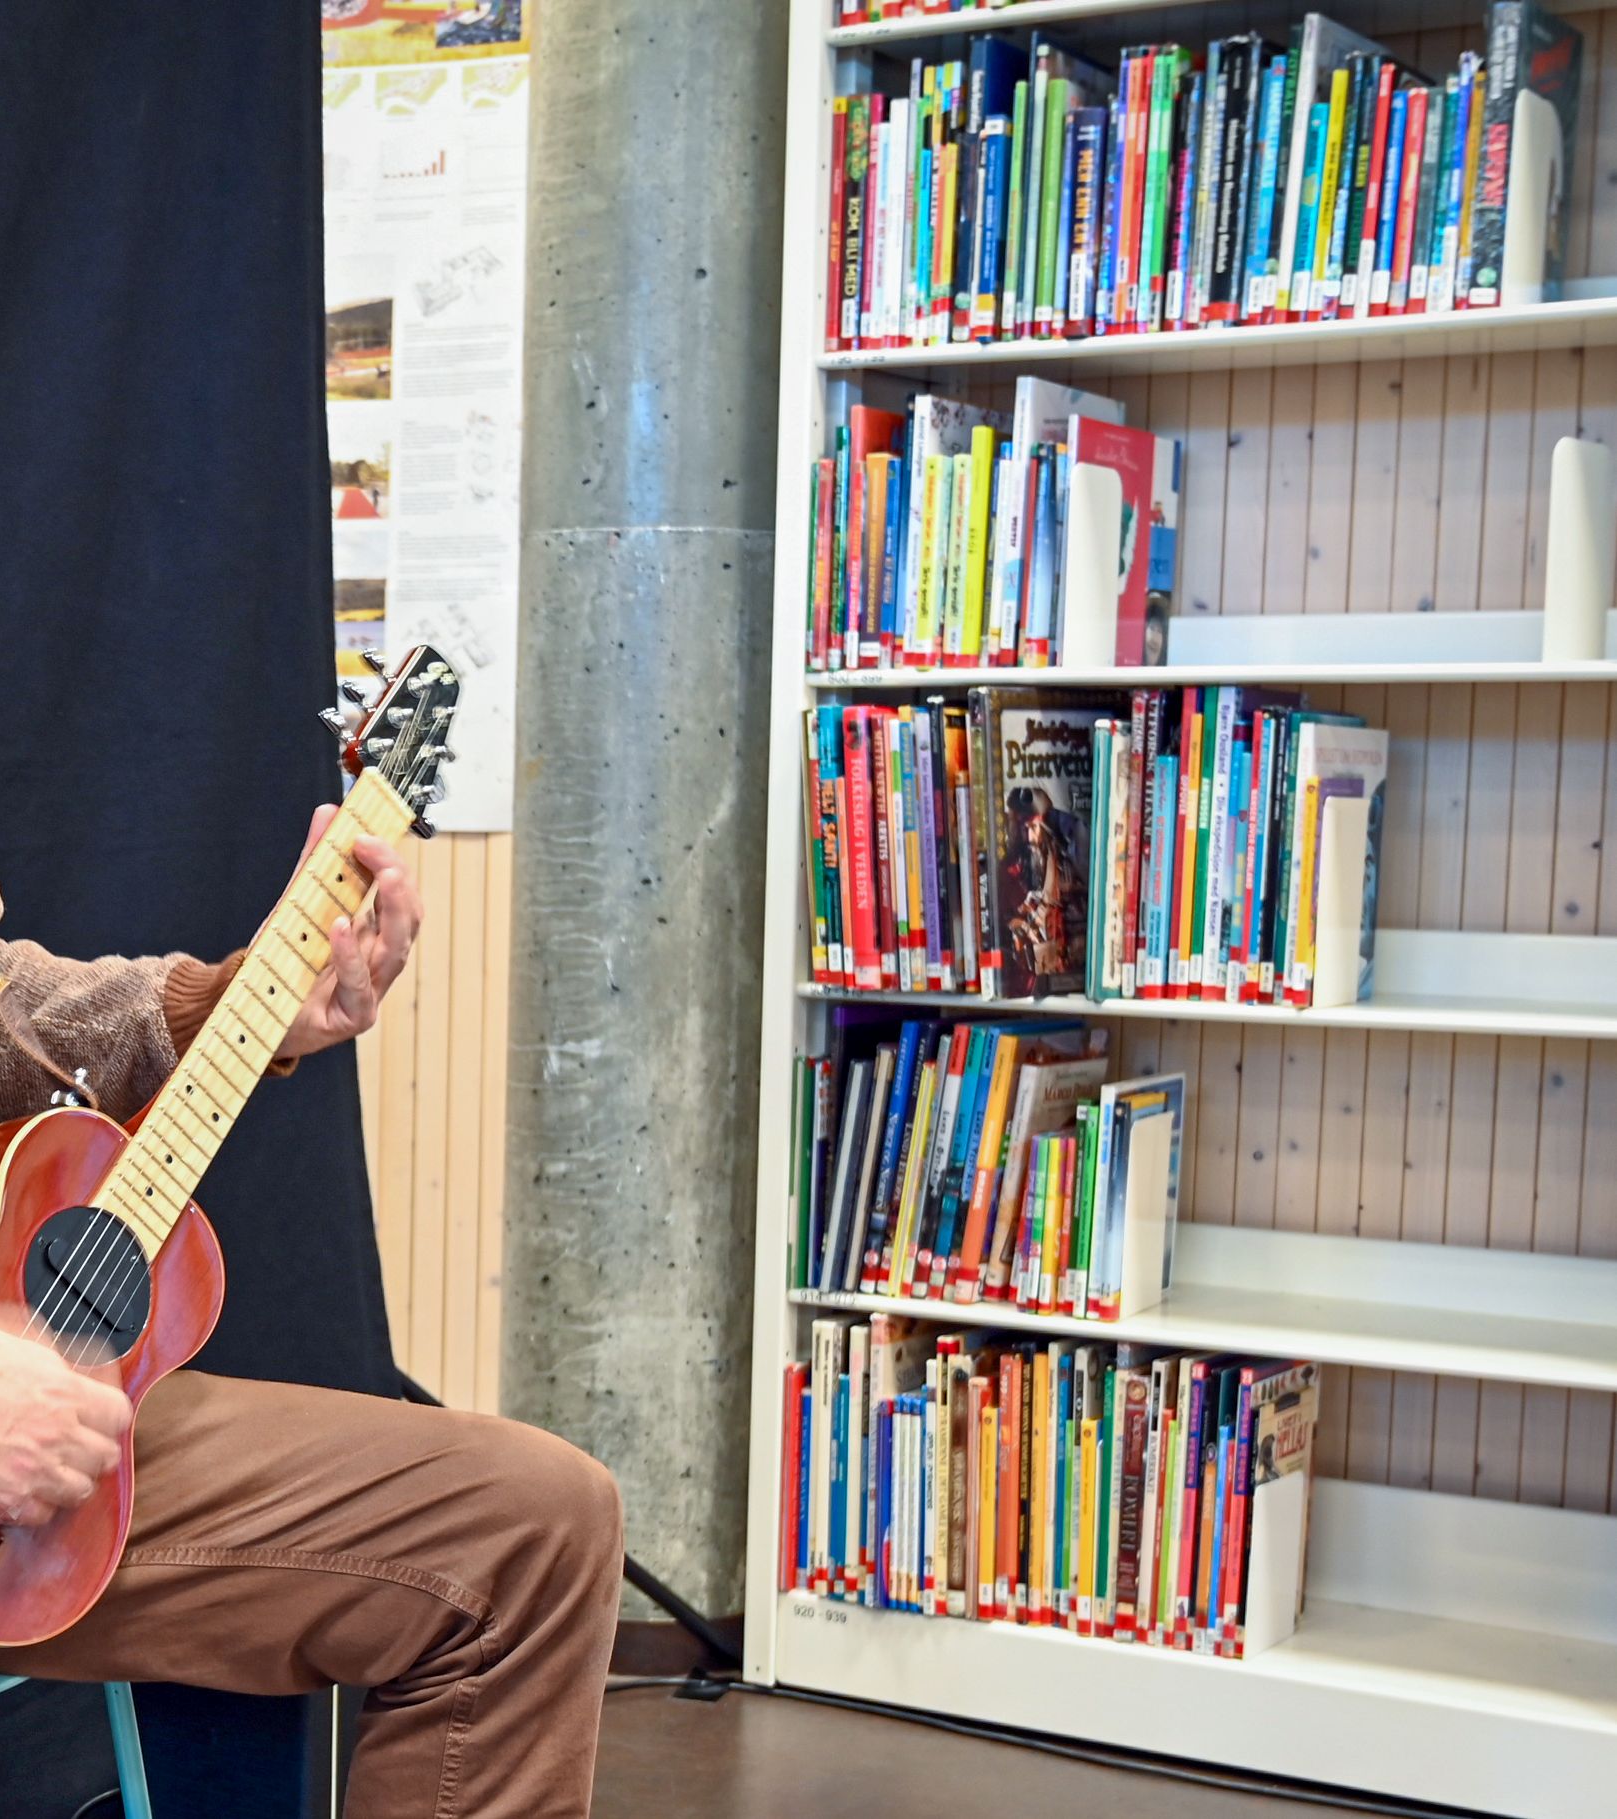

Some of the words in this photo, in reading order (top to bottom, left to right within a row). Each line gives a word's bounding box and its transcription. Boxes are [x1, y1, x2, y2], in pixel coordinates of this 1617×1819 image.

[1282, 48, 1301, 117] FOTBALL
[845, 237, 859, 260] BLI
[844, 262, 858, 297] MED
[1132, 715, 1145, 754] TITANIC
[1145, 699, 1160, 773] UTFORSK
[1219, 704, 1231, 731] Bjørn
[873, 730, 885, 767] METTE
[1217, 732, 1230, 775] Ousland
[820, 780, 837, 815] HELT
[850, 757, 867, 838] FOLKESLAG
[875, 770, 887, 815] NEWTH
[1141, 778, 1155, 842] TITANIC
[1198, 777, 1211, 830] AMUNDSEN
[1217, 796, 1226, 812] Din
[1250, 788, 1259, 821] NANSEN
[877, 819, 889, 861] ARKTIS
[1210, 815, 1225, 873] ekspedisjon
[1248, 822, 1257, 844] OVER
[855, 852, 870, 910] VERDEN
[1245, 845, 1255, 890] GRØNLAND
[1213, 877, 1221, 898] med
[1210, 900, 1220, 937] Nansen
[939, 1109, 952, 1140] LAND
[973, 1109, 986, 1139] LAND
[973, 1168, 989, 1210] BRASIL
